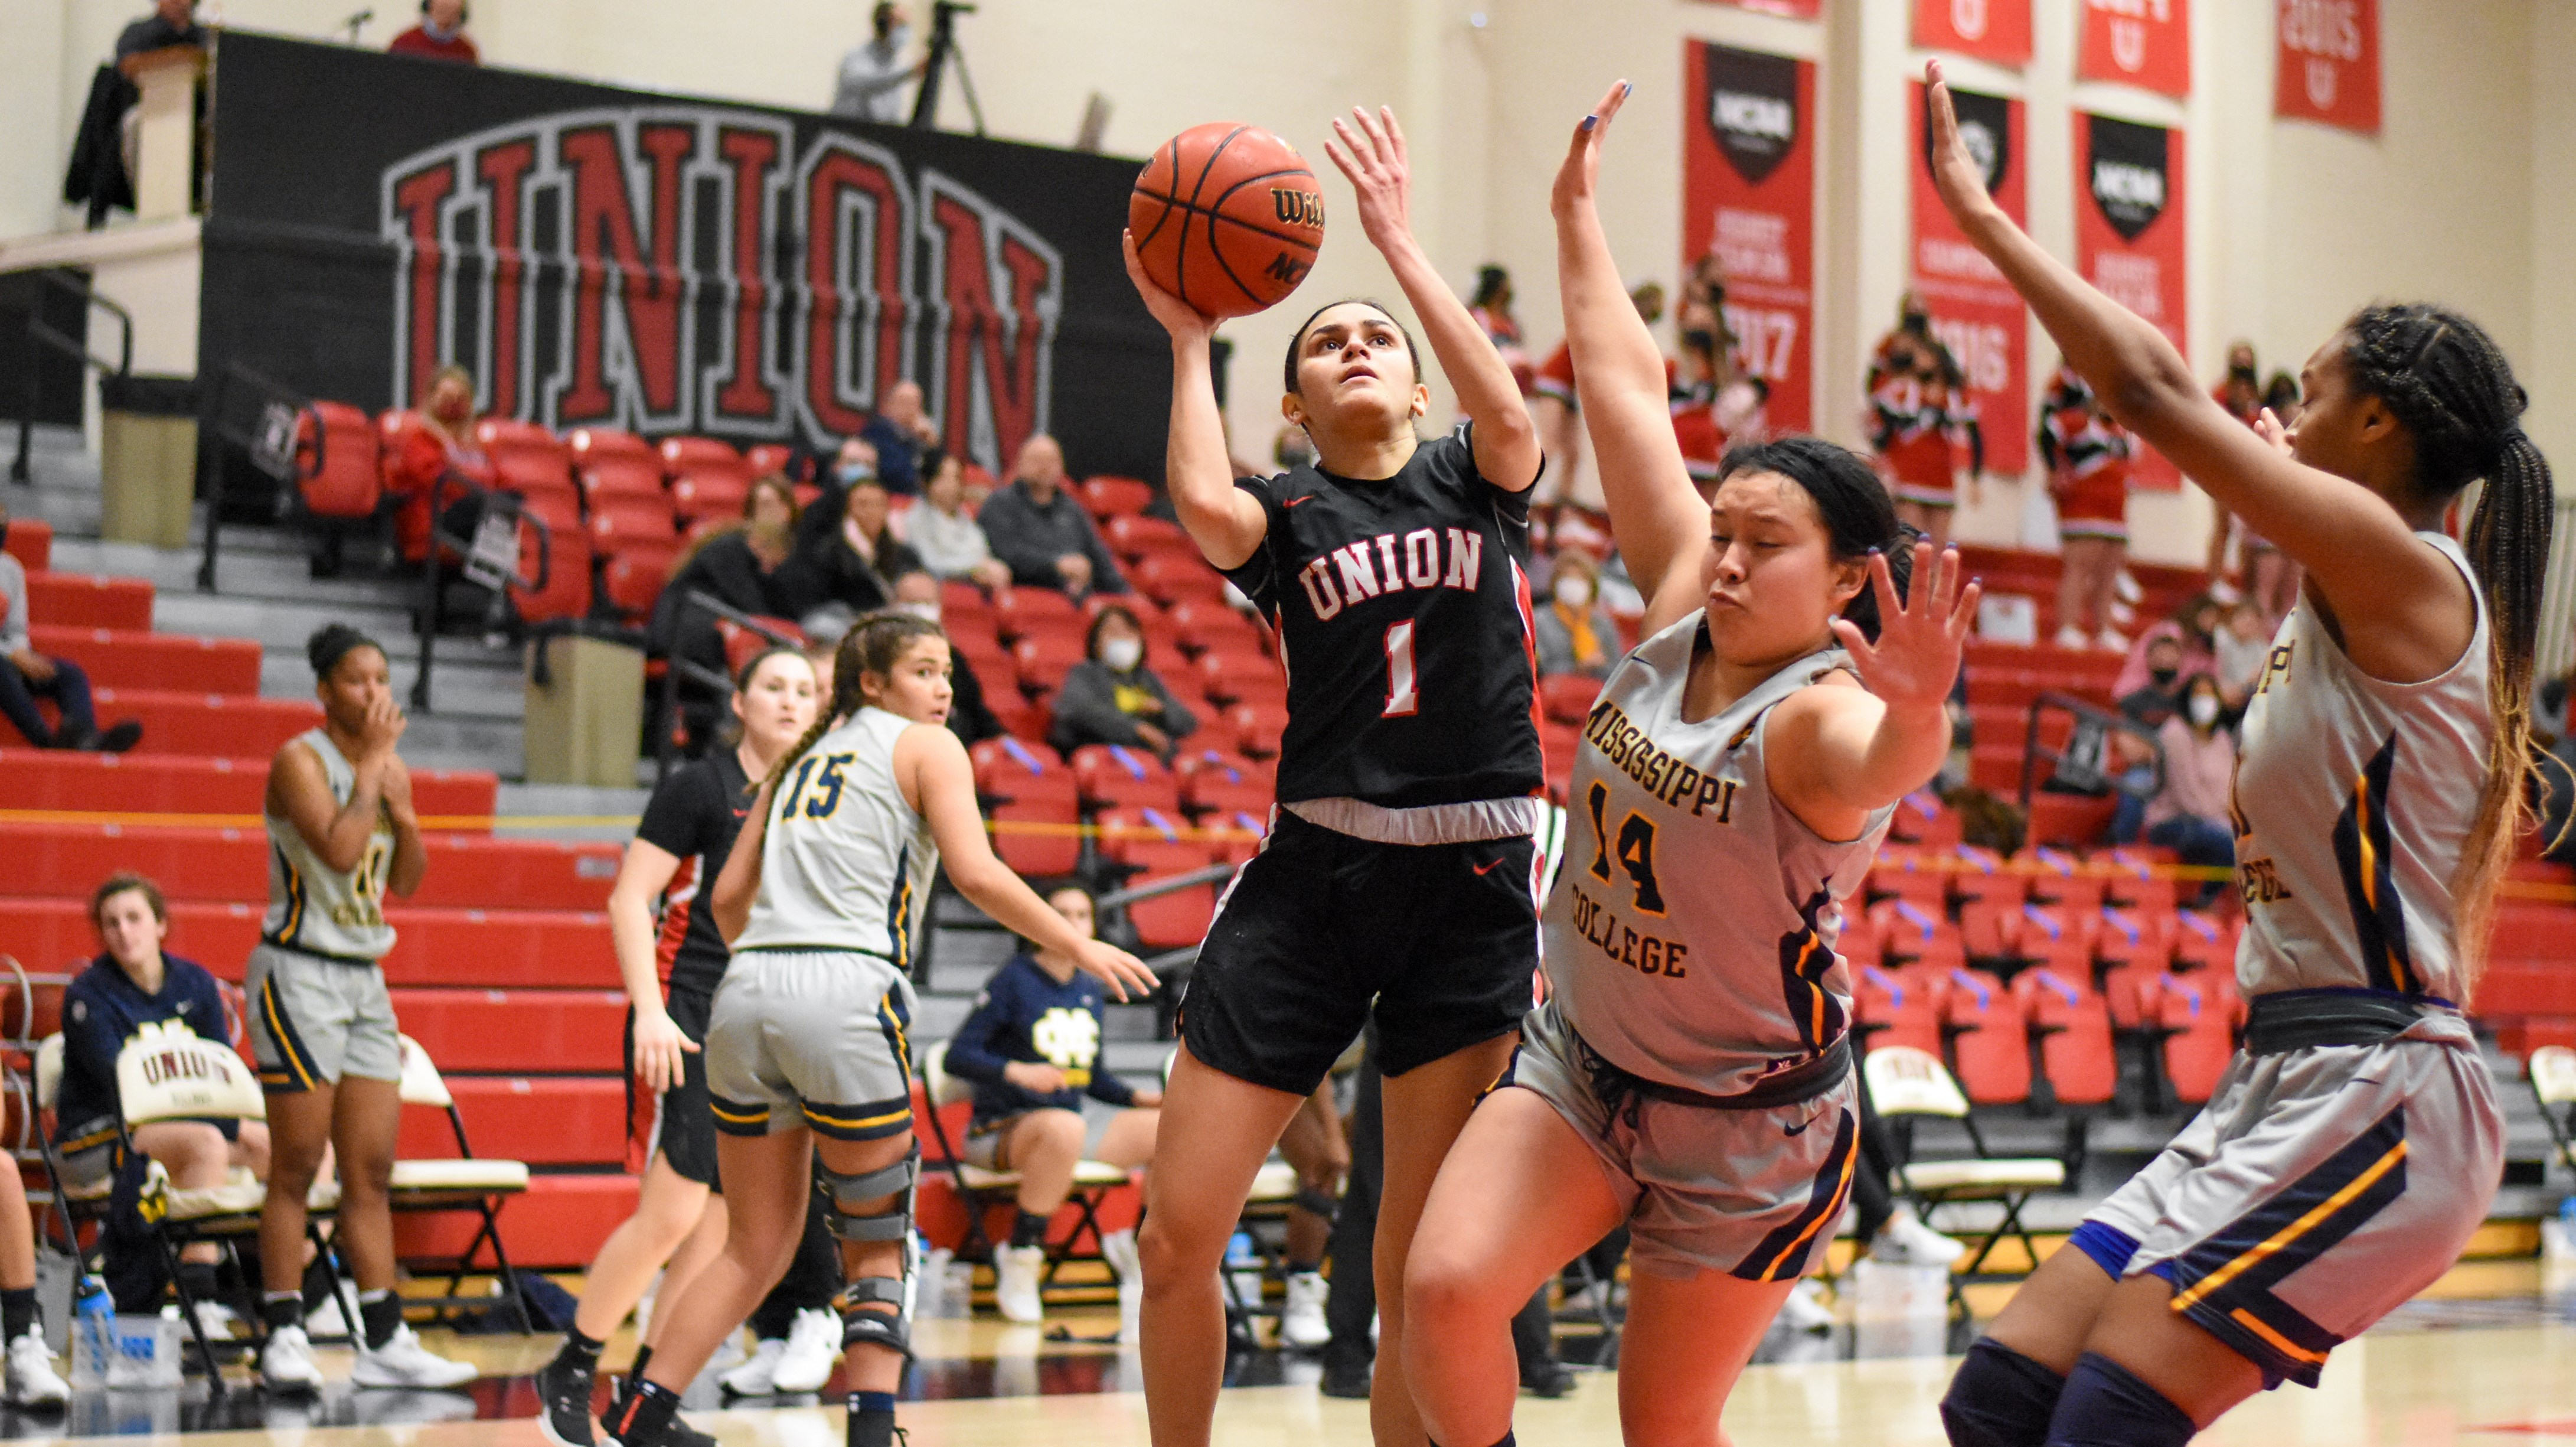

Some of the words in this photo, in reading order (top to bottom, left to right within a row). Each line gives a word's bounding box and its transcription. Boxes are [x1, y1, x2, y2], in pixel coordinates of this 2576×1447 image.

[381, 104, 1065, 477] UNION
[1265, 251, 1313, 285] NC
[1299, 526, 1483, 622] UNION
[1381, 618, 1419, 718] 1
[781, 750, 860, 825] 15
[1586, 778, 1668, 920] 14
[1571, 882, 1689, 979] COLLEGE
